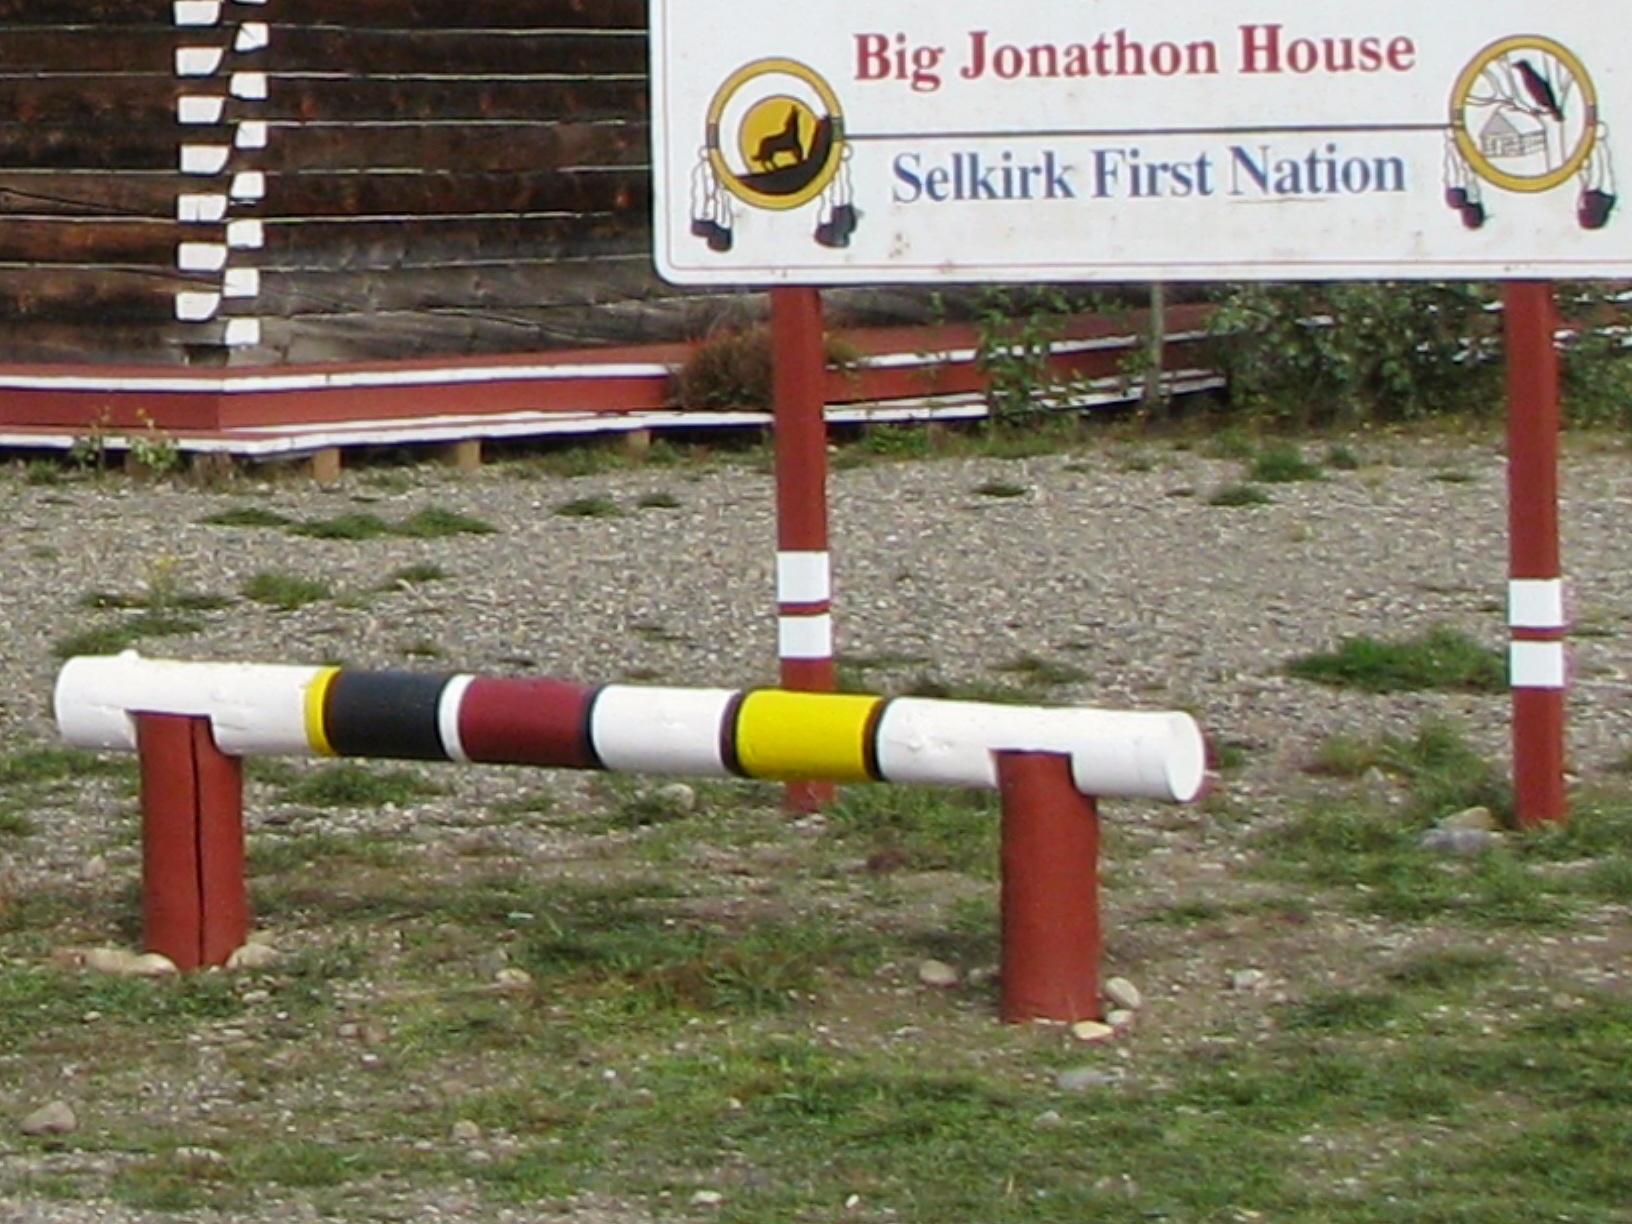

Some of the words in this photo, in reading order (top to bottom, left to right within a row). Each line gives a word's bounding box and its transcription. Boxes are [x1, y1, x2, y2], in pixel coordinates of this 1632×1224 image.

[854, 32, 945, 93] Big
[960, 28, 1220, 82] Jonathon
[1239, 24, 1416, 76] House
[892, 151, 1075, 205] Selkirk
[1091, 148, 1215, 200] First
[1227, 143, 1407, 197] Nation
